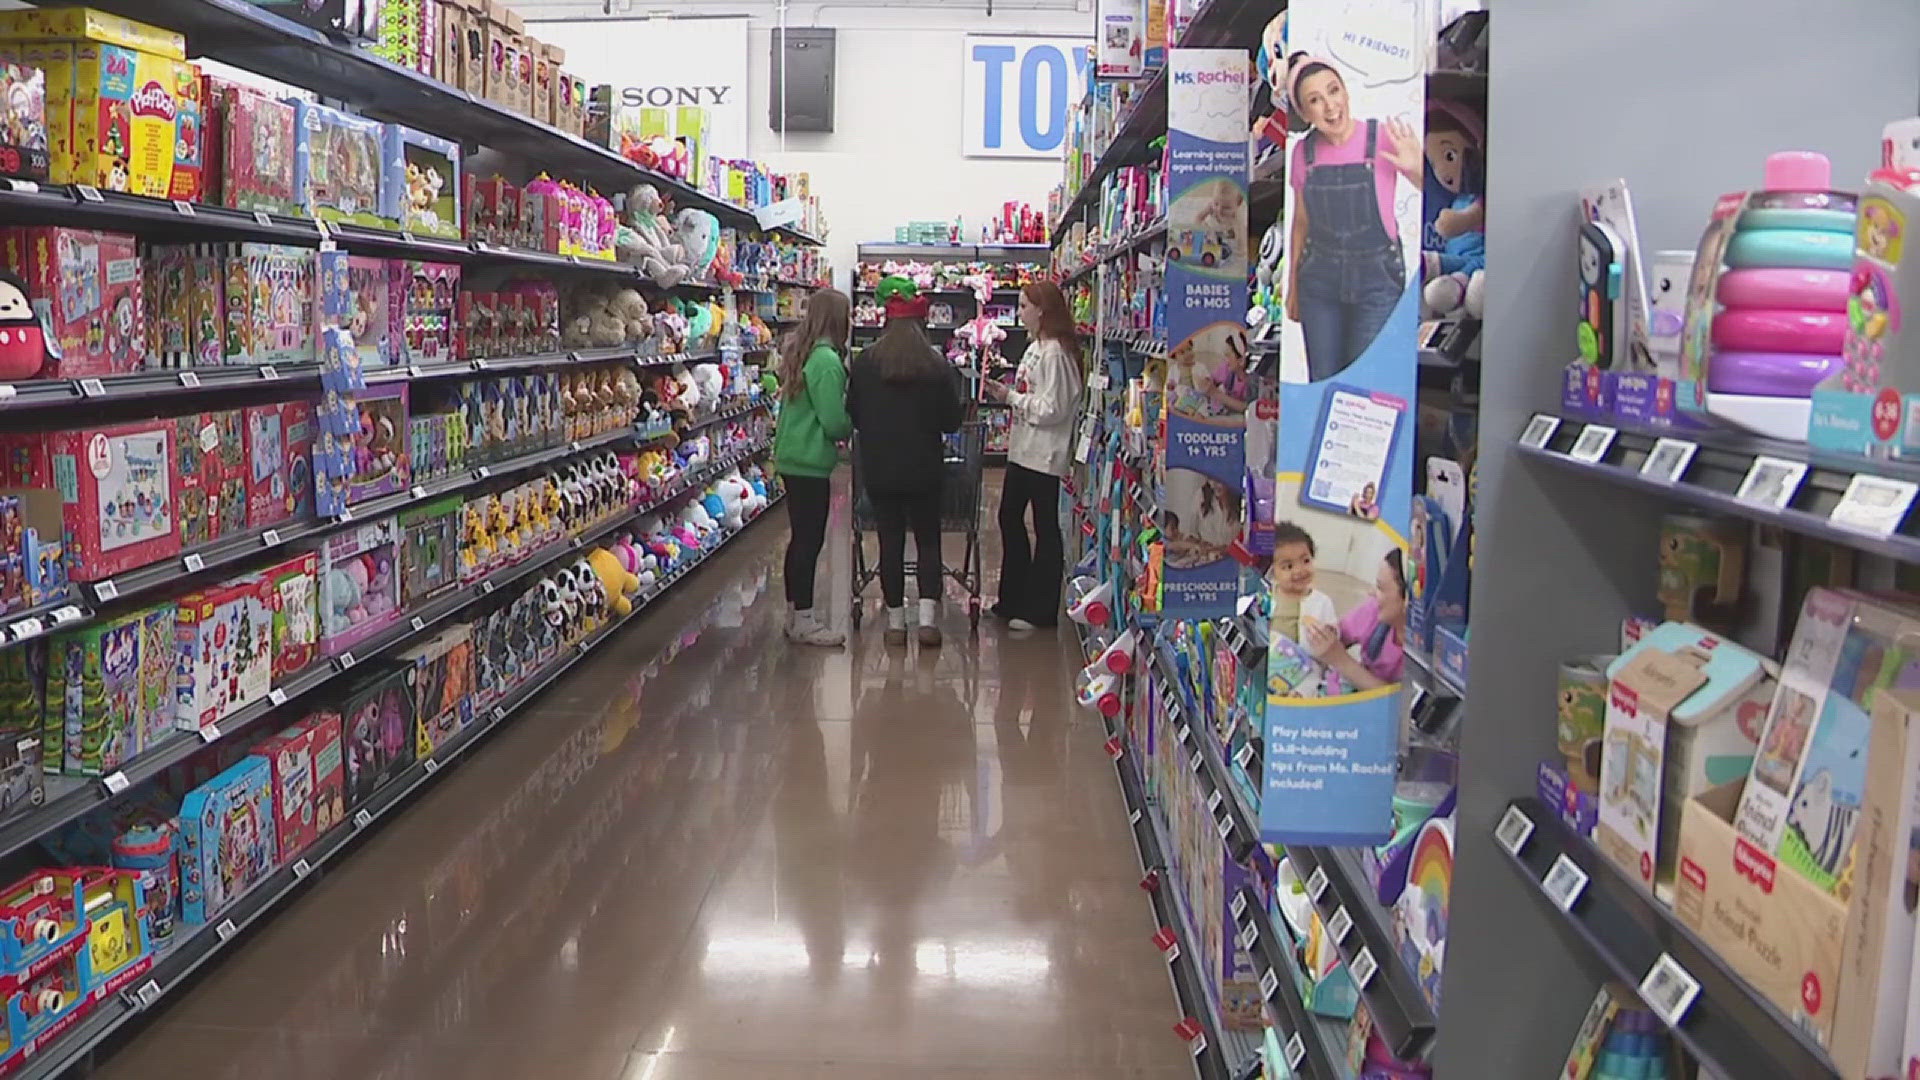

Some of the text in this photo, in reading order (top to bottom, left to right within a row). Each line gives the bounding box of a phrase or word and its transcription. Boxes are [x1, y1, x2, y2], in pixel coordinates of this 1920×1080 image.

[1343, 31, 1410, 60] HI FRIENDS!
[106, 55, 128, 74] 24
[1197, 69, 1245, 85] Rachel
[621, 85, 731, 107] SONY
[1173, 149, 1245, 163] Learning across
[1172, 163, 1195, 174] ages
[1196, 162, 1213, 172] and
[1186, 284, 1231, 296] BABIES
[1186, 297, 1231, 309] 0+ MOS
[1177, 432, 1238, 445] TODDLERS
[94, 437, 107, 459] 12
[1187, 446, 1227, 457] 1+ YRS
[1164, 582, 1237, 593] PRESCHOOLERS
[1183, 592, 1217, 602] 3+ YRS
[1272, 725, 1359, 741] Play ideas and
[1271, 761, 1293, 774] tips
[1296, 761, 1327, 774] from
[1351, 762, 1393, 774] Rachel
[1269, 778, 1324, 791] included!
